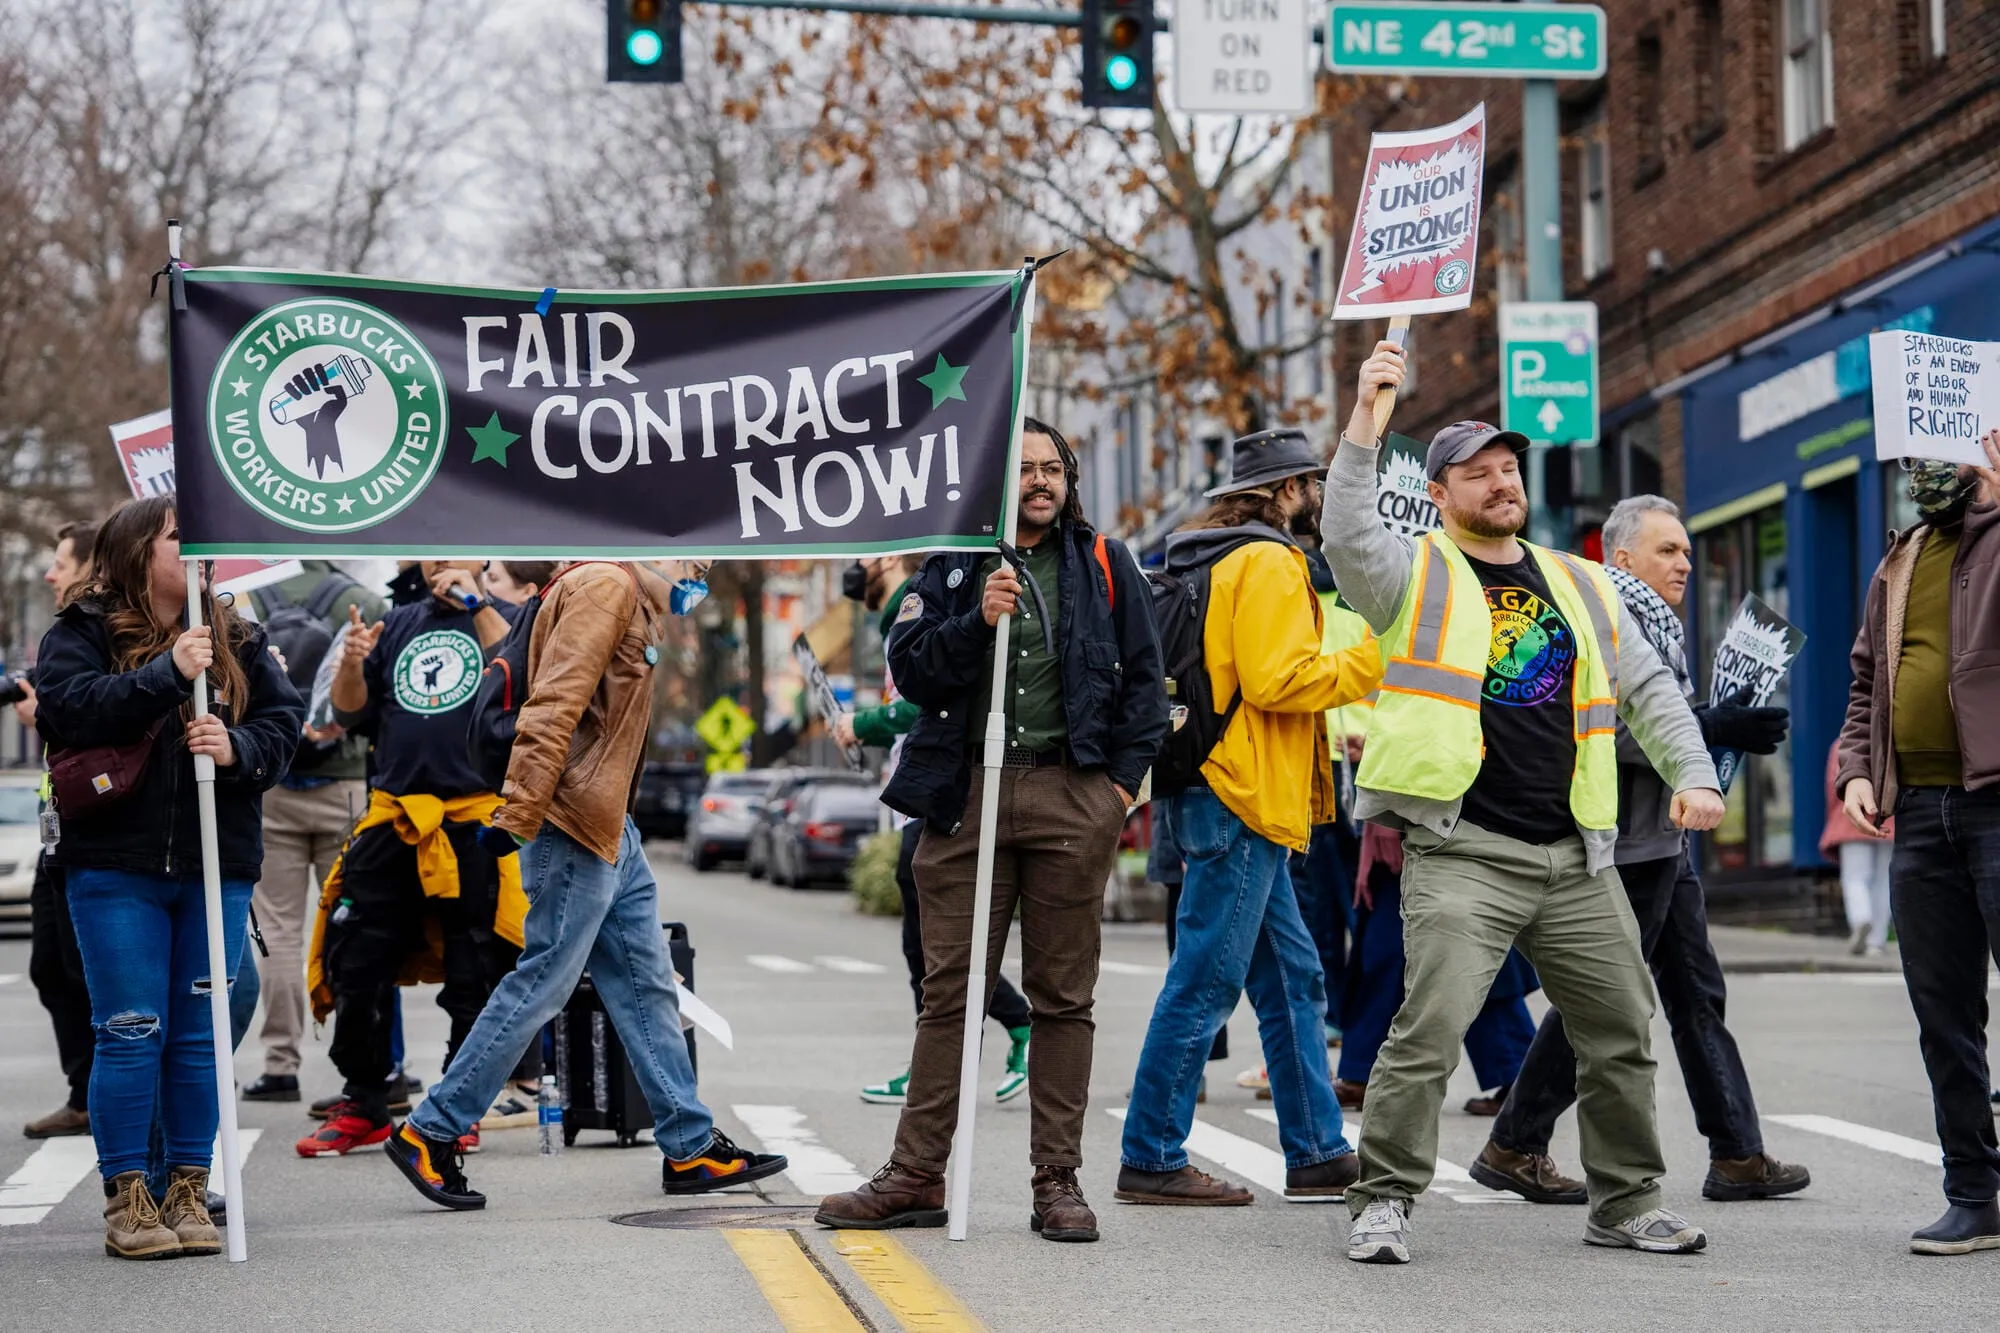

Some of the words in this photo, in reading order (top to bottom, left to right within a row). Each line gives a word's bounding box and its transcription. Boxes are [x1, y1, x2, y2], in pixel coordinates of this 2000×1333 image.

[1202, 0, 1279, 21] TURN
[1219, 32, 1261, 58] ON
[1342, 19, 1403, 54] NE
[1420, 20, 1516, 59] 42nd
[1541, 23, 1585, 59] St
[1211, 68, 1271, 95] RED
[1413, 165, 1441, 180] OUR
[1419, 204, 1431, 217] IS
[1368, 202, 1470, 255] STRONG!
[243, 313, 416, 374] STARBUCKS
[462, 312, 640, 392] FAIR
[1904, 335, 1973, 356] STARBUCKS
[1906, 355, 1920, 367] IS
[1930, 355, 1945, 368] AN
[1951, 358, 1980, 375] ENEMY
[1906, 372, 1920, 386] OF
[1928, 373, 1970, 393] LABOR
[1907, 388, 1923, 403] AND
[1930, 390, 1966, 408] HUMAN
[530, 350, 914, 479] CONTRACT
[1909, 406, 1979, 444] RIGHTS!
[225, 408, 327, 515] WORKERS
[359, 411, 431, 506] UNITED
[731, 424, 961, 539] NOW!
[1501, 591, 1557, 624] GAY
[408, 635, 474, 659] STARBUCKS
[1734, 630, 1777, 660] STARBUCKS
[1487, 648, 1519, 677] ORKERS
[1488, 647, 1569, 699] ORGANIZE
[1716, 644, 1779, 691] CONTRACT
[399, 670, 430, 707] WORKERS
[440, 670, 477, 704] UNITED
